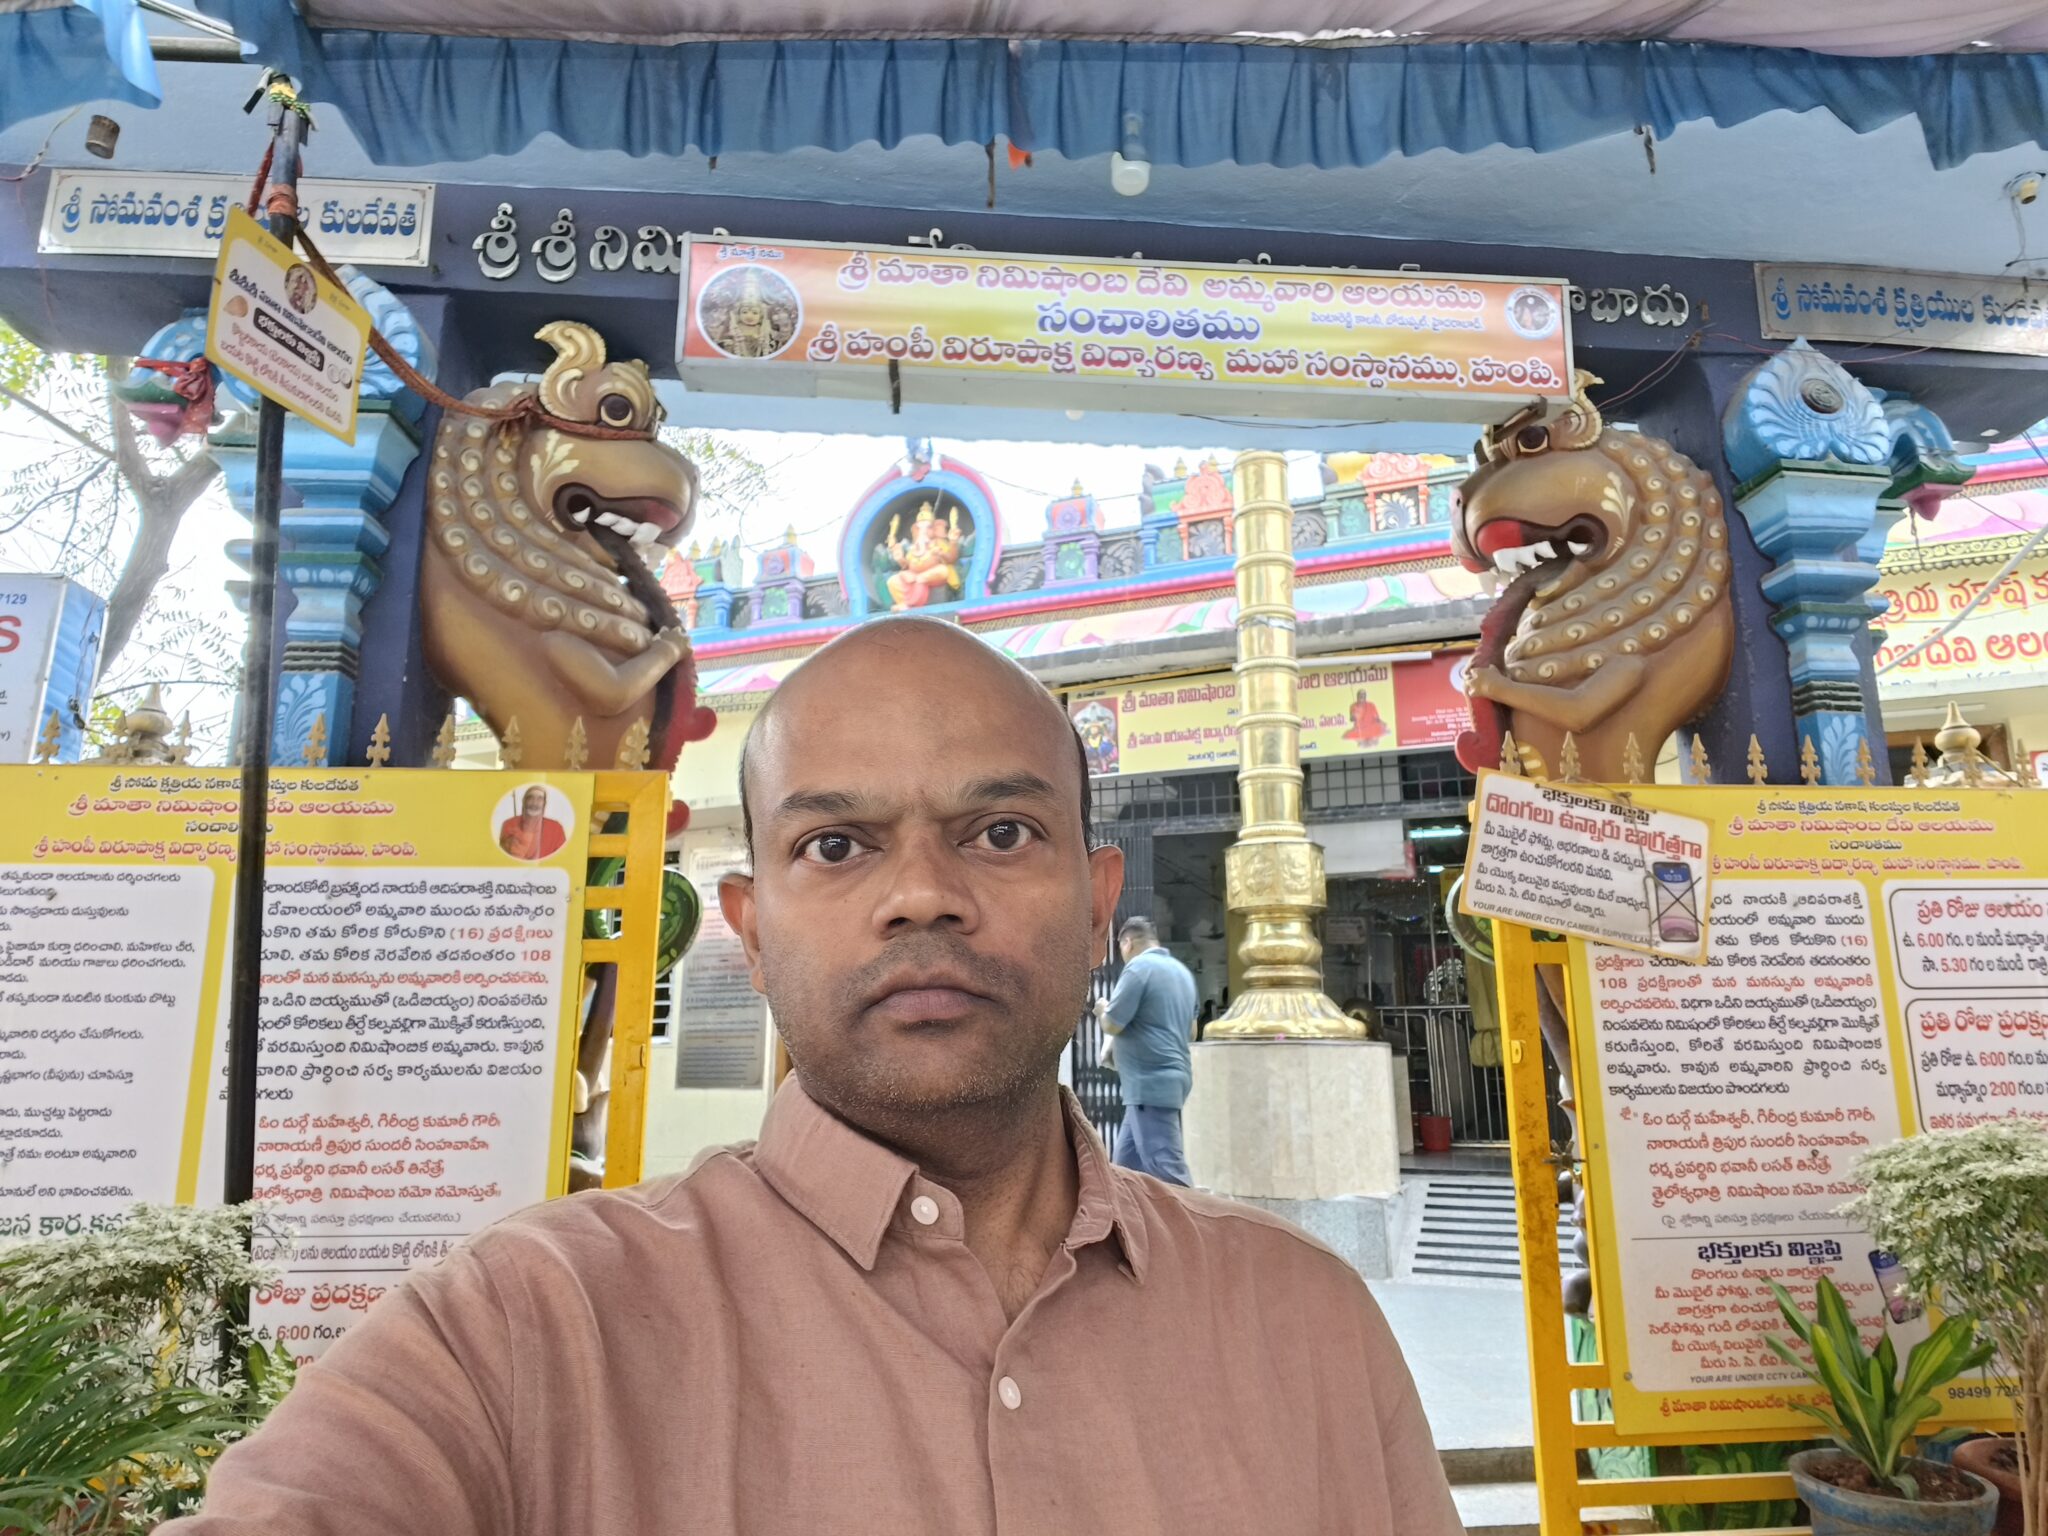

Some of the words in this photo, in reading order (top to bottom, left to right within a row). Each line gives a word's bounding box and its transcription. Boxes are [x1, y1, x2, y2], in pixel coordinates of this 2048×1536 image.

[61, 187, 82, 233] శ్రీ
[90, 191, 202, 227] సోమవంశ
[319, 197, 417, 237] కులదేవత
[472, 202, 520, 280] శ్రీ
[531, 207, 577, 283] శ్రీ
[838, 251, 872, 290] శ్రీ
[876, 260, 969, 286] మాతా
[976, 265, 1129, 297] నిమిషాంబ
[1136, 268, 1189, 297] దేవి
[1202, 277, 1334, 313] అమ్మవారి
[1343, 283, 1485, 311] ఆలయము
[1772, 277, 1791, 321] శ్రీ
[1796, 283, 1888, 317] సోమవంశ
[1893, 286, 1974, 331] క్షత్రియుల
[1037, 301, 1260, 341] సంచాలితము
[808, 322, 839, 363] శ్రీ
[846, 328, 934, 361] హంపీ
[942, 337, 1077, 374] విరూపాక్ష
[1082, 340, 1214, 381] విద్యారణ్య
[1226, 349, 1301, 374] మహా
[1121, 690, 1136, 713] శ్రీ
[1139, 692, 1175, 708] మాతా
[1177, 683, 1236, 704] నిమిషాంబ
[1324, 666, 1388, 687] ఆలయము
[110, 776, 122, 792] శ్రీ
[301, 778, 359, 792] కులదేవత
[69, 794, 87, 815] శ్రీ
[93, 800, 151, 812] మాతా
[299, 802, 394, 814] ఆలయము
[1542, 788, 1605, 812] భక్తులకు
[1912, 801, 1960, 812] కులదేవత
[1486, 792, 1553, 825] దొంగలు
[1559, 810, 1621, 843] ఉన్నారు
[1625, 827, 1703, 860] జాగ్రత్తగా
[1728, 816, 1744, 835] శ్రీ
[1747, 819, 1797, 832] మాతా
[1800, 819, 1881, 835] నిమిషాంబ
[1885, 816, 1914, 832] దేవి
[1918, 820, 1995, 832] ఆలయము
[34, 836, 49, 858] శ్రీ
[100, 842, 166, 861] విరూపాక్ష
[169, 842, 237, 861] విద్యారణ్య
[1483, 820, 1496, 836] మీ
[1496, 824, 1528, 846] మొబైల్
[1557, 840, 1599, 859] ఆభరణాలు
[1602, 849, 1611, 862] &
[1481, 842, 1518, 862] జాగ్రత్తగా
[1585, 865, 1614, 881] మనవి.
[382, 881, 427, 895] నాయకి
[429, 881, 495, 898] ఆదిపరాశక్తి
[495, 882, 557, 897] నిమిషాంబ
[1474, 878, 1496, 894] మీరు
[1477, 862, 1489, 876] మీ
[1489, 867, 1517, 884] యొక్క
[1597, 888, 1616, 902] మీరే
[268, 903, 362, 917] దేవాలయంలో
[365, 905, 427, 921] అమ్మవారి
[430, 905, 481, 917] ముందు
[484, 905, 555, 921] నమస్కారం
[1473, 901, 1496, 912] YOUR
[1496, 905, 1514, 916] ARE
[1514, 909, 1543, 921] UNDER
[1544, 915, 1567, 926] CCTV
[1566, 919, 1601, 935] CAMERA
[1916, 899, 1943, 925] ప్రతి
[1947, 896, 1980, 918] రోజు
[306, 927, 336, 940] తమ
[341, 925, 379, 939] కోరిక
[383, 925, 446, 940] కోరుకొని
[450, 927, 485, 941] (16)
[487, 927, 553, 944] ప్రదక్షిణలు
[1902, 931, 1915, 947] ఉ.
[1917, 932, 1944, 947] 6.00
[1945, 932, 1964, 947] గం.
[1965, 934, 1974, 947] ల
[1976, 928, 2003, 946] నుండి
[39, 957, 81, 968] మరియు
[121, 957, 186, 969] ధరించగలరు.
[299, 950, 329, 962] తమ
[333, 948, 371, 961] కోరిక
[373, 948, 433, 962] నెరవేరిన
[436, 950, 516, 962] తదనంతరం
[521, 950, 551, 962] 108
[1922, 955, 1939, 972] సా.
[1941, 957, 1968, 973] 5.30
[1996, 953, 2024, 971] నుండి
[7, 993, 60, 1006] తప్పకుండా
[1920, 1011, 1951, 1039] ప్రతి
[1954, 1006, 1993, 1031] రోజు
[79, 1026, 144, 1040] చేసుకోగలరు.
[267, 1041, 347, 1058] వరమిస్తుంది
[349, 1041, 429, 1055] నిమిషాంబిక
[432, 1041, 499, 1057] అమ్మవారు.
[503, 1041, 544, 1053] కావున
[1921, 1050, 1938, 1072] ప్రతి
[1941, 1047, 1963, 1066] రోజు
[1965, 1050, 1978, 1066] ఉ.
[1979, 1051, 2006, 1066] 6:00
[362, 1065, 394, 1081] సర్వ
[396, 1064, 483, 1081] కార్యములను
[486, 1064, 542, 1077] విజయం
[1607, 1062, 1671, 1078] అమ్మవారు.
[1681, 1062, 1720, 1075] కావున
[1729, 1061, 1793, 1077] అమ్మవారిని
[1861, 1059, 1888, 1075] సర్వ
[1608, 1083, 1677, 1100] కార్యములను
[1678, 1083, 1724, 1095] విజయం
[1725, 1082, 1790, 1095] పొందగలరు
[1936, 1080, 1988, 1103] మధ్యాహ్నం
[1990, 1081, 2016, 1096] 2:00
[258, 1117, 280, 1129] ఓం
[282, 1114, 309, 1135] దుర్గే
[82, 1149, 137, 1163] అమ్మవారిని
[38, 1186, 57, 1197] అని
[1698, 1241, 1783, 1265] భక్తులకు
[1788, 1238, 1842, 1265] విజ్ఞప్తి
[258, 1327, 272, 1340] ఉ.
[276, 1325, 310, 1341] 6:00
[1690, 1375, 1713, 1384] YOUR
[1715, 1374, 1733, 1383] ARE
[1735, 1373, 1763, 1383] UNDER
[1765, 1372, 1788, 1381] CCTV
